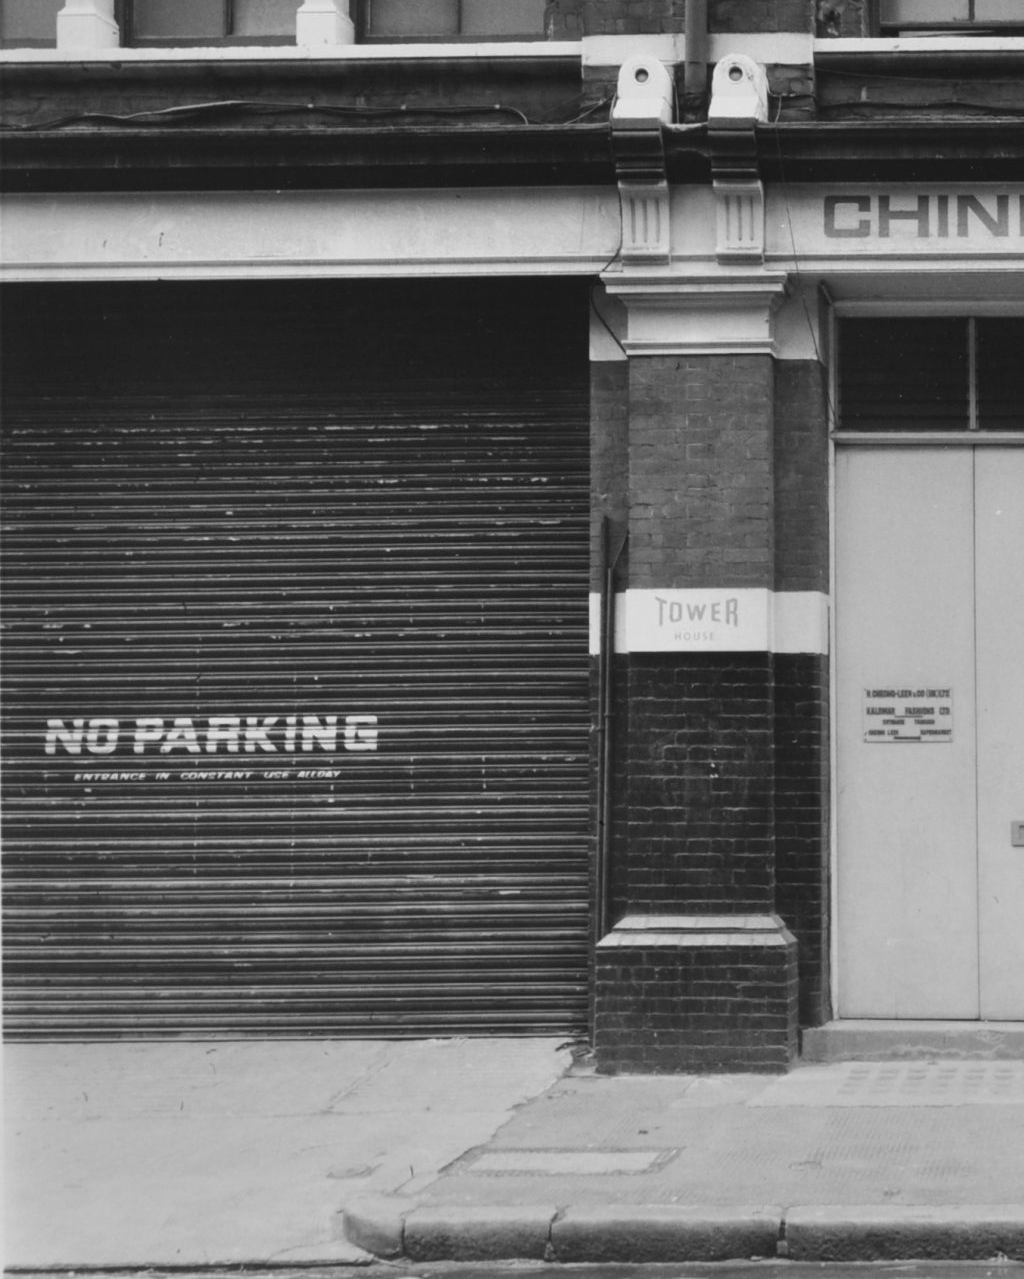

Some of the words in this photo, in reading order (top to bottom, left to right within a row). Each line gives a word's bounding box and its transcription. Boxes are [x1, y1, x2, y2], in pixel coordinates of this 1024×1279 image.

[654, 596, 739, 627] TOWER
[674, 631, 716, 641] HOUSE
[44, 718, 120, 755] NO
[132, 715, 378, 754] PARKING
[73, 772, 147, 782] ENTRANCE
[154, 772, 170, 782] IN
[179, 771, 254, 781] CONSTANT
[263, 771, 290, 780] USE
